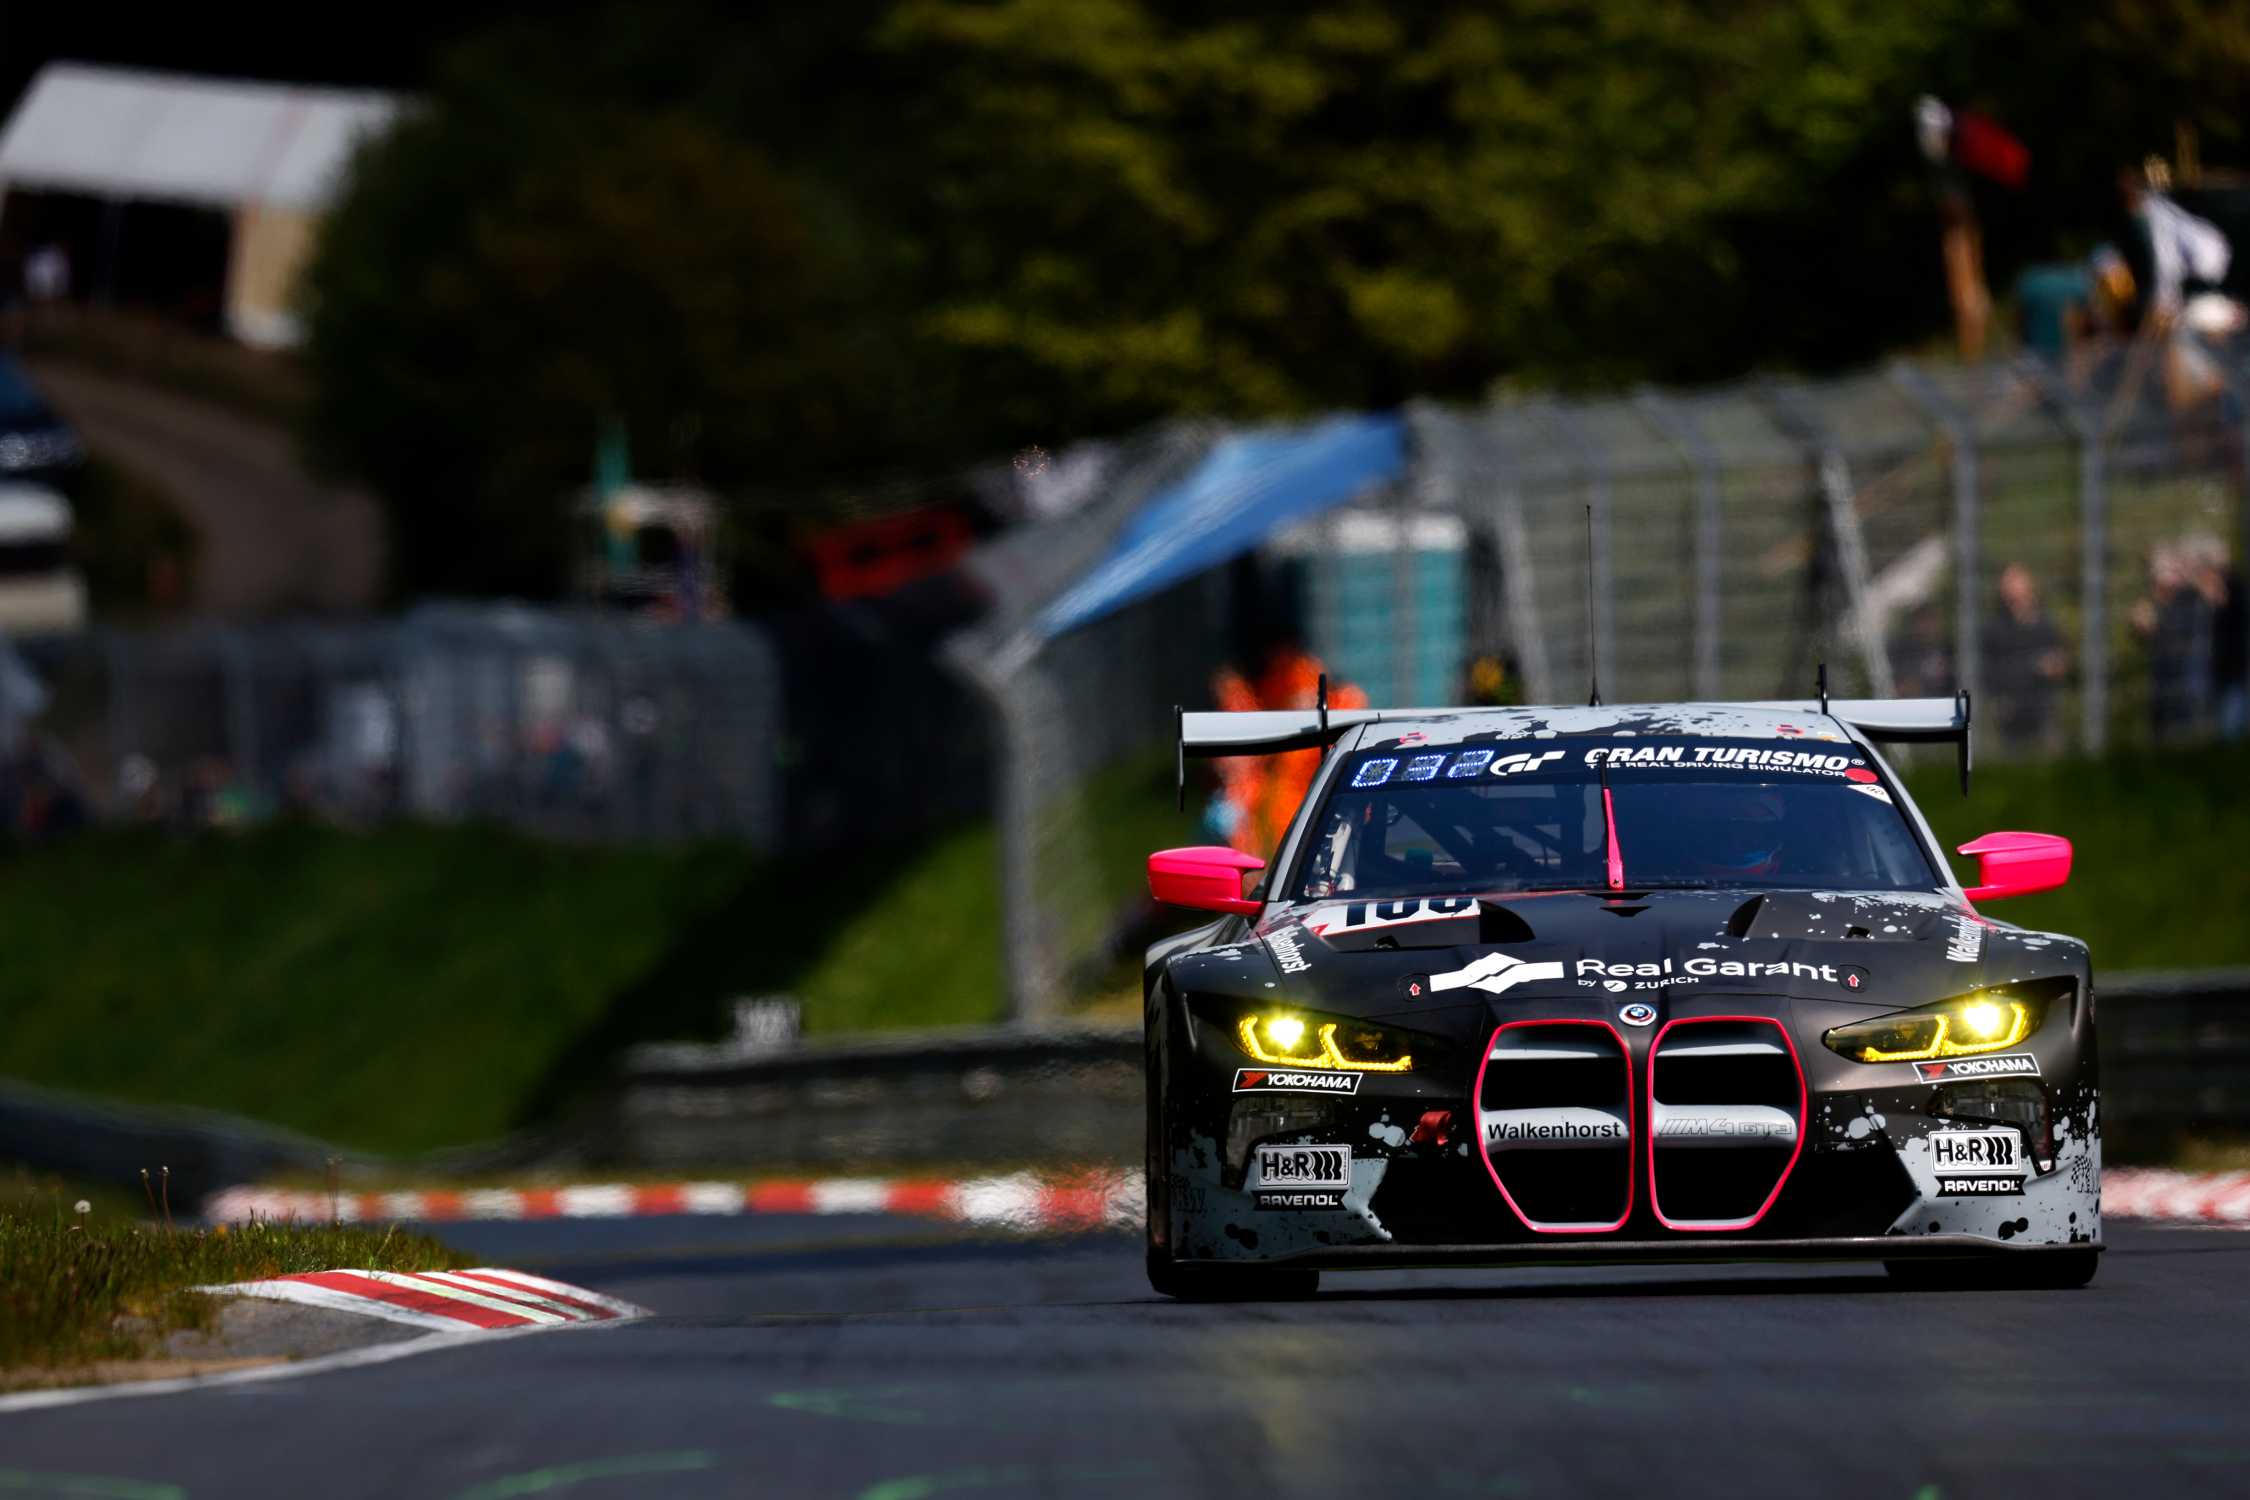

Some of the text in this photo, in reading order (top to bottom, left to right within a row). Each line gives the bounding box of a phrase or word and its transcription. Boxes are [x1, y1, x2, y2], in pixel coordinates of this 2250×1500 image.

[1584, 746, 1685, 763] GRAN
[1625, 761, 1671, 769] REAL
[1673, 761, 1744, 770] DRIVING
[1752, 763, 1846, 778] SIMULATOR
[1576, 957, 1839, 983] Real Garant
[1577, 975, 1700, 990] by ZURICH
[1946, 1058, 2034, 1075] YOKOHAMA
[1267, 1073, 1352, 1090] YOKOHAMA
[1488, 1121, 1622, 1140] Walkenhorst
[1935, 1137, 1984, 1163] H&R
[1261, 1152, 1311, 1178] H&R
[1944, 1179, 2019, 1193] RAVENOL
[1260, 1194, 1339, 1206] RAVENOL
